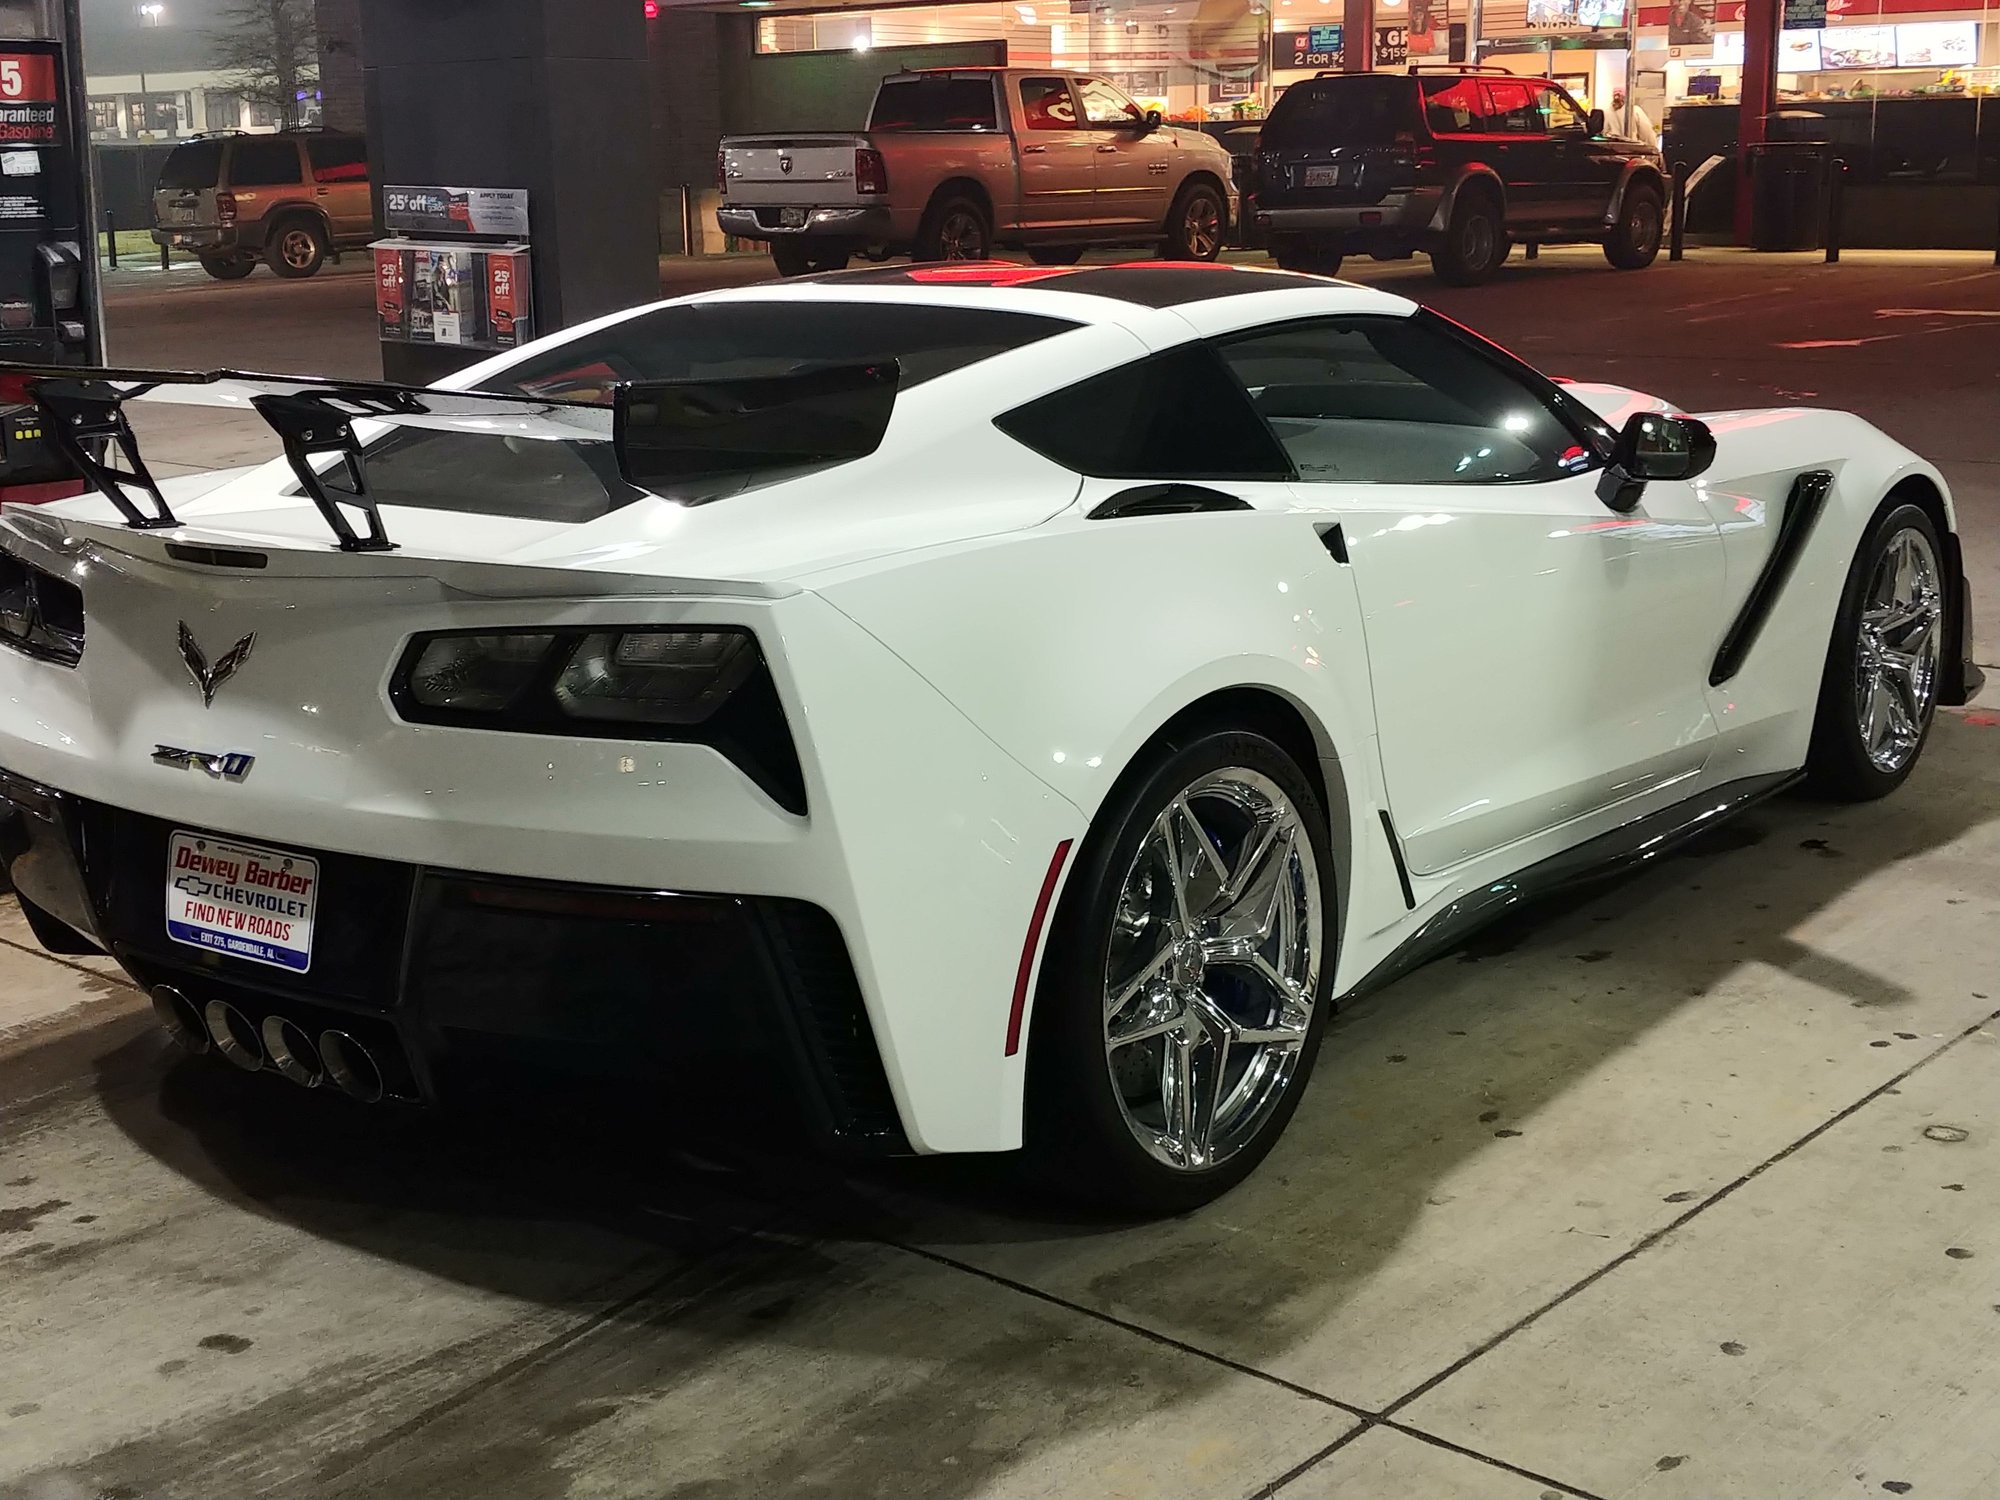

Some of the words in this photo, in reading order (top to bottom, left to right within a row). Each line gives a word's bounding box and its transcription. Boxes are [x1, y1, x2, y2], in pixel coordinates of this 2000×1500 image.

[1294, 52, 1304, 65] 2
[1306, 53, 1328, 65] FOR
[1, 60, 22, 96] 5
[0, 123, 53, 139] Gasoline
[409, 195, 427, 212] off
[382, 277, 397, 289] off
[494, 284, 510, 296] off
[175, 846, 240, 885] Dewey
[244, 862, 313, 895] Barber
[213, 883, 308, 918] CHEVROLET
[184, 901, 215, 923] FIND
[216, 909, 248, 930] NEW
[248, 916, 291, 941] ROADS
[200, 932, 213, 944] EXIT
